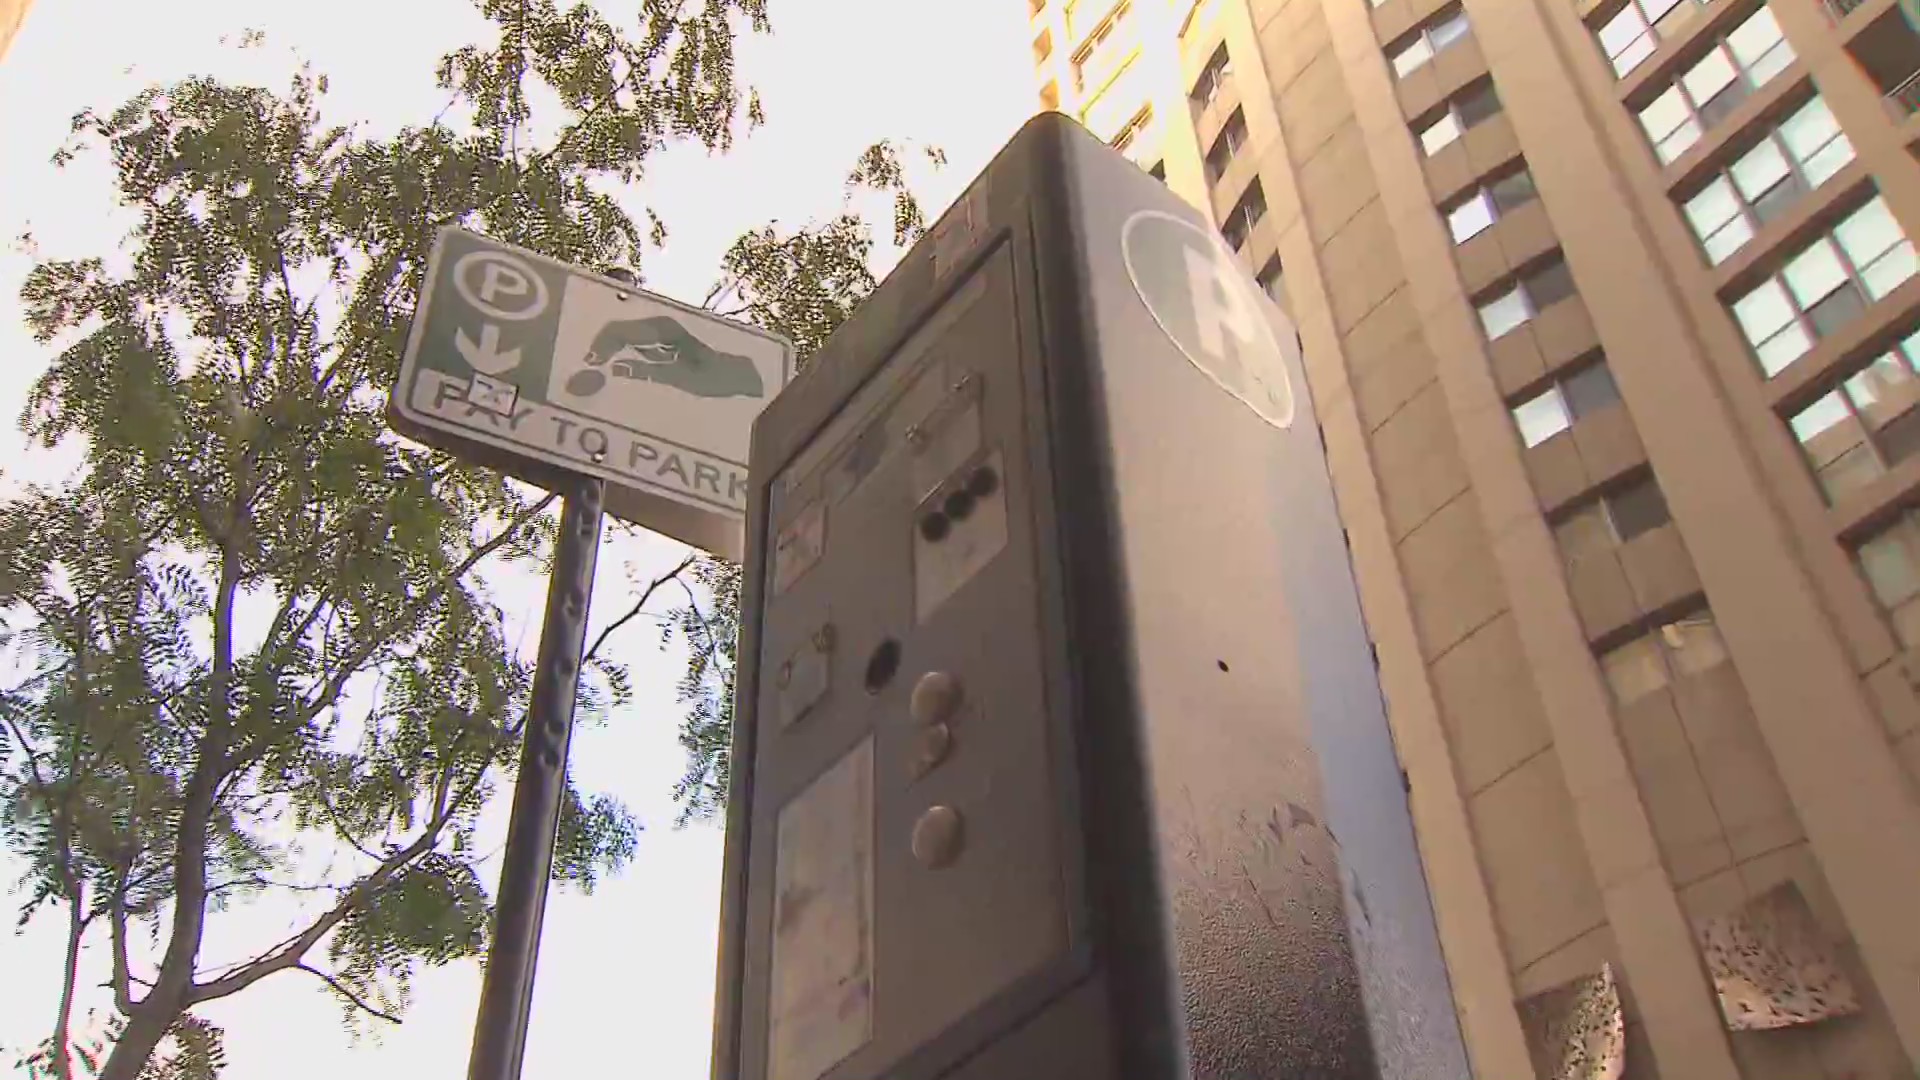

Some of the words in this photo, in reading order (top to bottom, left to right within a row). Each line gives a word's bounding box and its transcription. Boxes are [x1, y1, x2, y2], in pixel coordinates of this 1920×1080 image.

[480, 262, 529, 303] P
[551, 417, 608, 457] TO
[629, 441, 748, 499] PARK
